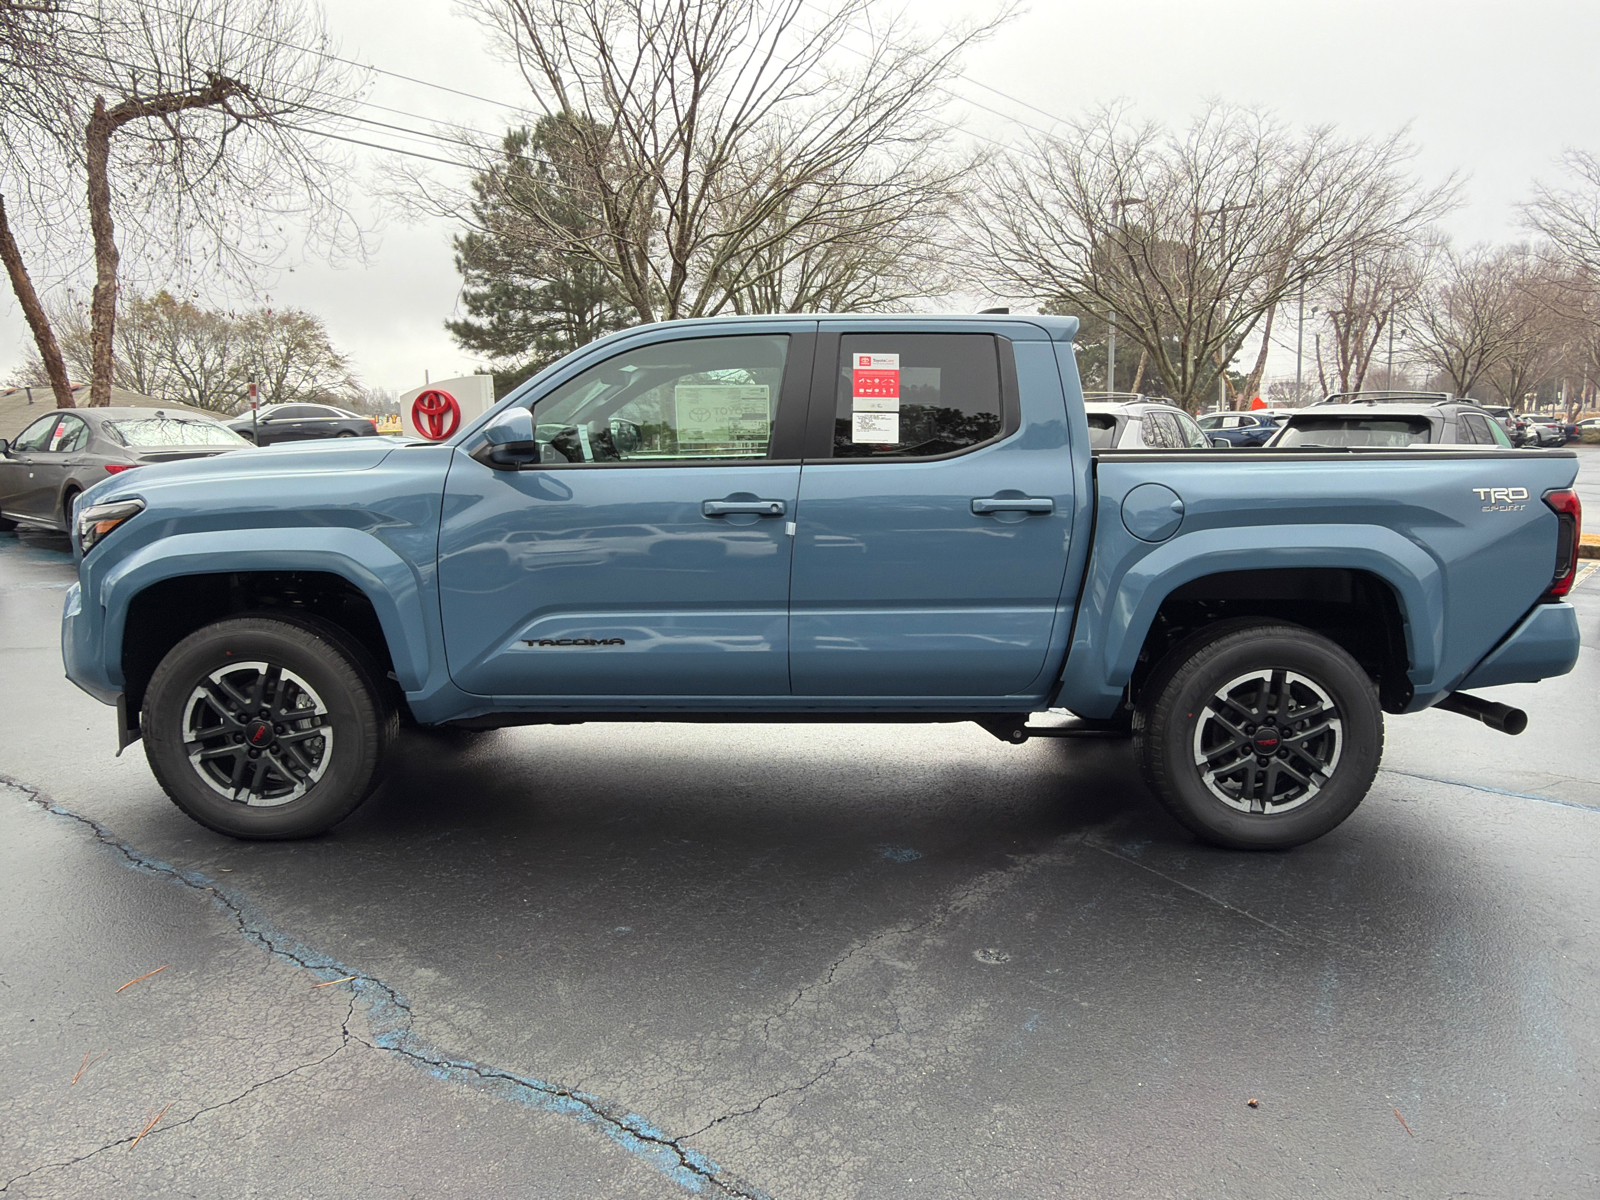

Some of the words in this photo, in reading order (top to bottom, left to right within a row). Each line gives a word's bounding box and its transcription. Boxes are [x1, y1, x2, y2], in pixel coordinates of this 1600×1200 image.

[1472, 487, 1529, 504] TRD
[1481, 504, 1526, 513] SPORT
[520, 637, 626, 647] TACOMA
[1257, 738, 1278, 746] TRD
